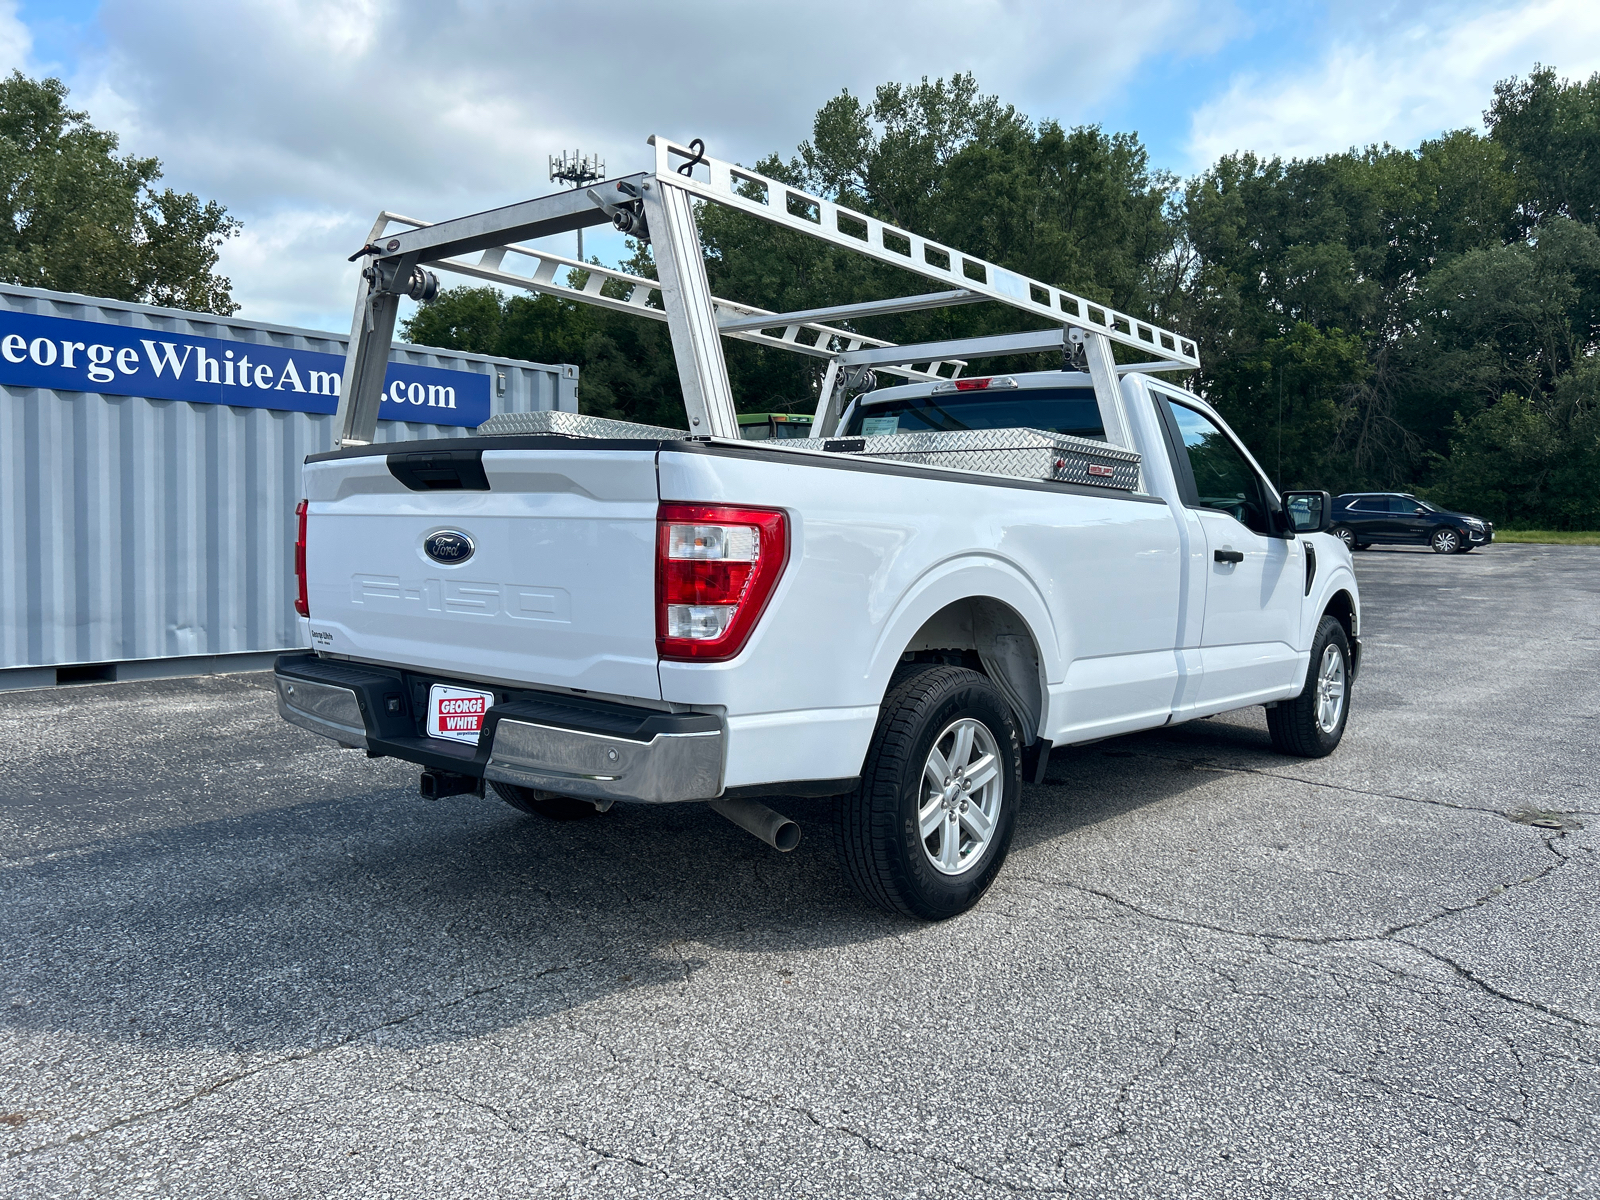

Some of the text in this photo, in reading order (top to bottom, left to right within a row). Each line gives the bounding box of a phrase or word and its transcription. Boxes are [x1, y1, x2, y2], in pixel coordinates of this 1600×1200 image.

[1, 333, 457, 409] eorgeWhiteAm.com
[433, 536, 460, 557] Ford
[351, 573, 572, 624] F-150
[441, 699, 483, 714] GEORGE
[446, 716, 478, 730] WHITE
